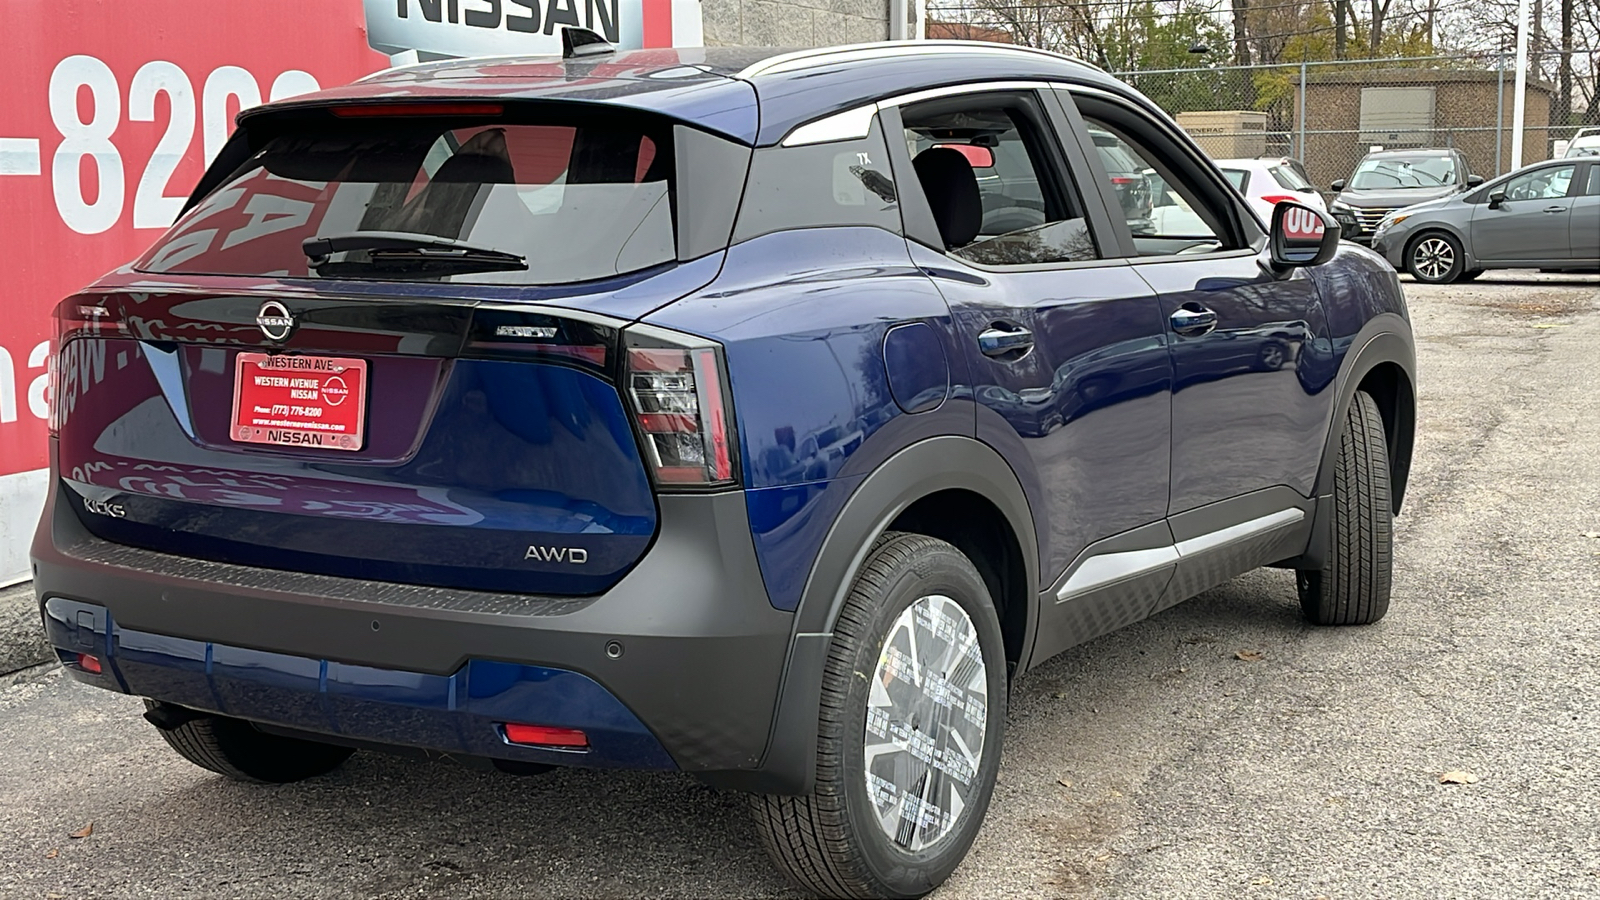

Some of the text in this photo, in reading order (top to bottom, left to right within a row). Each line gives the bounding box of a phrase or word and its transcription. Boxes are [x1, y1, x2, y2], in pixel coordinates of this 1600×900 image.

[856, 152, 872, 165] TX
[256, 317, 294, 326] NISSAN
[267, 357, 333, 371] WESTERN AVE
[254, 376, 319, 389] WESTERN AVENUE
[290, 389, 318, 400] NISSAN
[253, 405, 322, 417] Phone: (773) 776-8200
[252, 418, 346, 431] www.westernavenissan.com
[268, 430, 322, 445] NISSAN
[83, 498, 126, 517] KICKS
[524, 545, 588, 563] AWD
